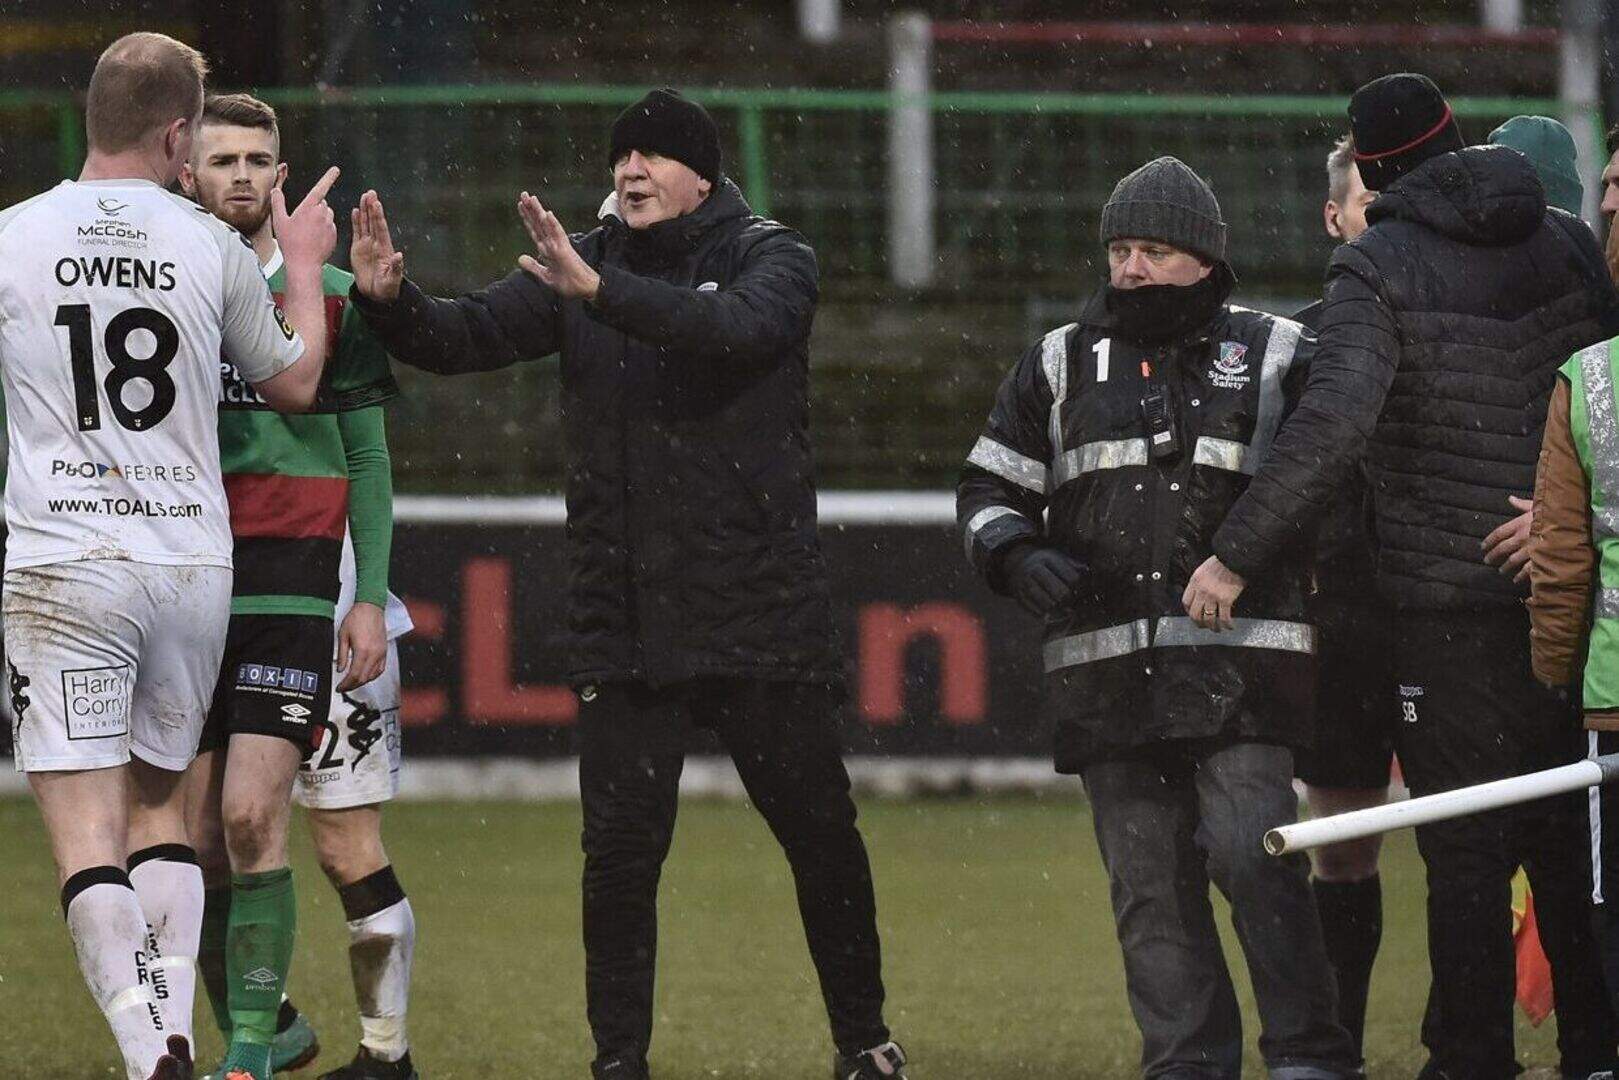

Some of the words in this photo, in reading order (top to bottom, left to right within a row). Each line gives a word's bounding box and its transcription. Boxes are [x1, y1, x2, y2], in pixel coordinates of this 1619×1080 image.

[77, 225, 147, 240] McCosh
[77, 238, 110, 247] FUNERAL
[55, 256, 176, 291] OWENS
[54, 304, 180, 432] 18
[1092, 338, 1111, 382] 1
[1208, 370, 1250, 382] Stadium
[1212, 379, 1245, 390] Safety
[51, 460, 96, 479] P&O
[48, 498, 202, 517] www.TOALScom
[71, 676, 124, 696] Harry
[72, 696, 125, 717] Corry
[299, 720, 344, 773] 2
